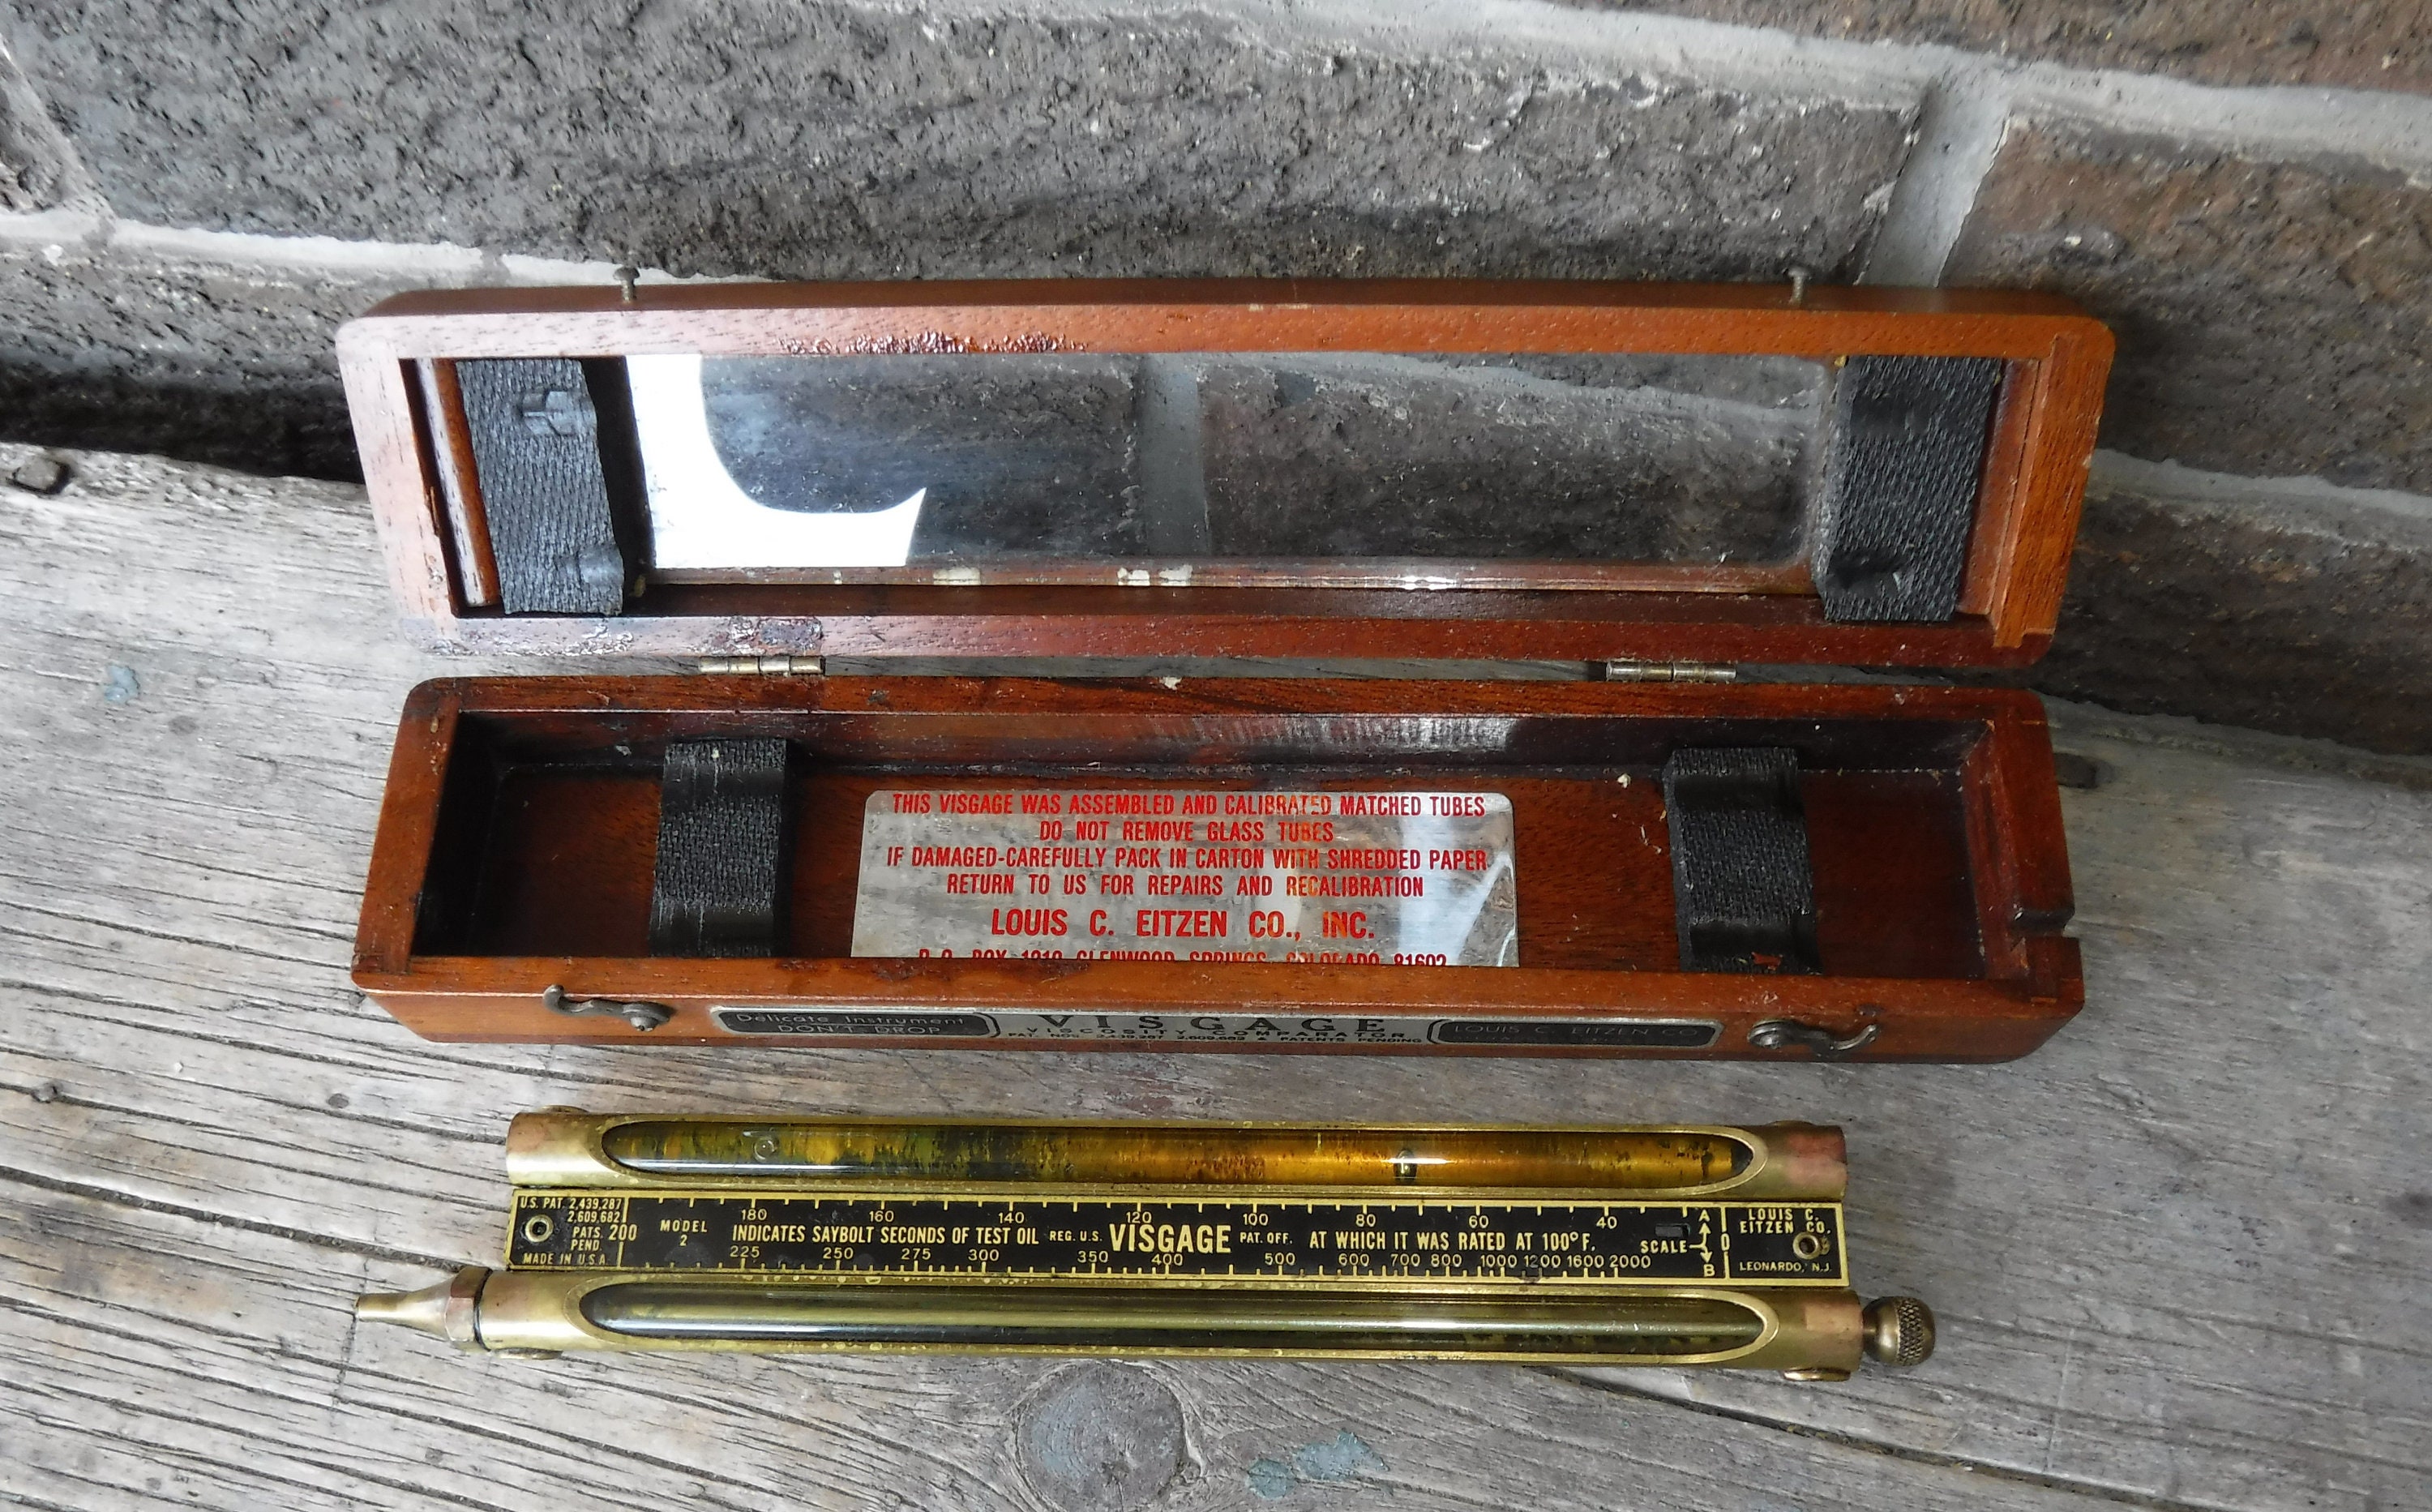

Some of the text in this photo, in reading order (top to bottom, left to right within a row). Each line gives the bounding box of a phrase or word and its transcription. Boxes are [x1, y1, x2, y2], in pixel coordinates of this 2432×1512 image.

[893, 794, 1486, 817] THIS VISGAGE WAS ASSEMBLED AND CALIBRATED MATCHED TUBES
[1039, 820, 1334, 842] DO NOT REMOVE GLASS TUBES
[887, 846, 1487, 871] IF DAMAGED-CAREFULLY PACK IN CARTON WITH SHREDDED PAPER
[947, 874, 1424, 897] RETURN TO US FOR REPAIRS AND RECALIBRATION
[991, 909, 1068, 936] LOUIS
[1090, 910, 1114, 936] C.
[1137, 910, 1227, 937] EITZEN
[1322, 911, 1375, 940] INC.
[736, 1013, 965, 1026] Delicate Instrument
[1039, 1015, 1385, 1032] VISGAGE
[874, 1026, 940, 1034] DROP
[520, 1197, 539, 1209] U.S.
[741, 1208, 768, 1221] 180
[869, 1210, 894, 1223] 160
[998, 1211, 1025, 1224] 140
[1126, 1211, 1152, 1224] 120
[1243, 1213, 1269, 1226] 100
[1355, 1214, 1377, 1227] 80
[1698, 1210, 1711, 1222] A
[1748, 1208, 1820, 1221] LOUIS C.
[660, 1219, 708, 1233] MODEL
[1468, 1215, 1489, 1228] 60
[1595, 1216, 1617, 1229] 40
[1740, 1221, 1831, 1234] EITZEN CO.
[572, 1225, 603, 1240] PATS.
[608, 1224, 638, 1241] 200
[732, 1224, 1039, 1244] INDICATES SAYBOLT SECONDS OF TEST OIL
[1049, 1230, 1103, 1242] REG. U.S.
[1109, 1223, 1232, 1254] VISGAGE
[1240, 1231, 1293, 1244] PAT. OFF.
[679, 1235, 687, 1247] 2
[1309, 1231, 1327, 1249] AT
[1336, 1231, 1385, 1249] WHICH
[1394, 1231, 1408, 1250] IT
[1417, 1231, 1449, 1250] WAS
[1458, 1232, 1505, 1251] RATED
[1515, 1232, 1534, 1251] AT
[1640, 1240, 1688, 1253] SCALE
[730, 1245, 760, 1258] 225
[823, 1247, 854, 1260] 250
[901, 1248, 931, 1261] 275
[968, 1249, 1000, 1261] 300
[1077, 1250, 1108, 1263] 350
[522, 1253, 554, 1264] MADE
[559, 1253, 571, 1265] IN
[1151, 1253, 1184, 1266] 400
[1265, 1253, 1295, 1266] 500
[1338, 1253, 1370, 1266] 600
[1390, 1253, 1420, 1266] 700
[1430, 1253, 1462, 1267] 800
[1480, 1254, 1518, 1268] 1000
[1523, 1255, 1561, 1268] 1200
[1567, 1255, 1604, 1268] 1600
[1609, 1255, 1651, 1269] 2000
[1703, 1264, 1715, 1277] B
